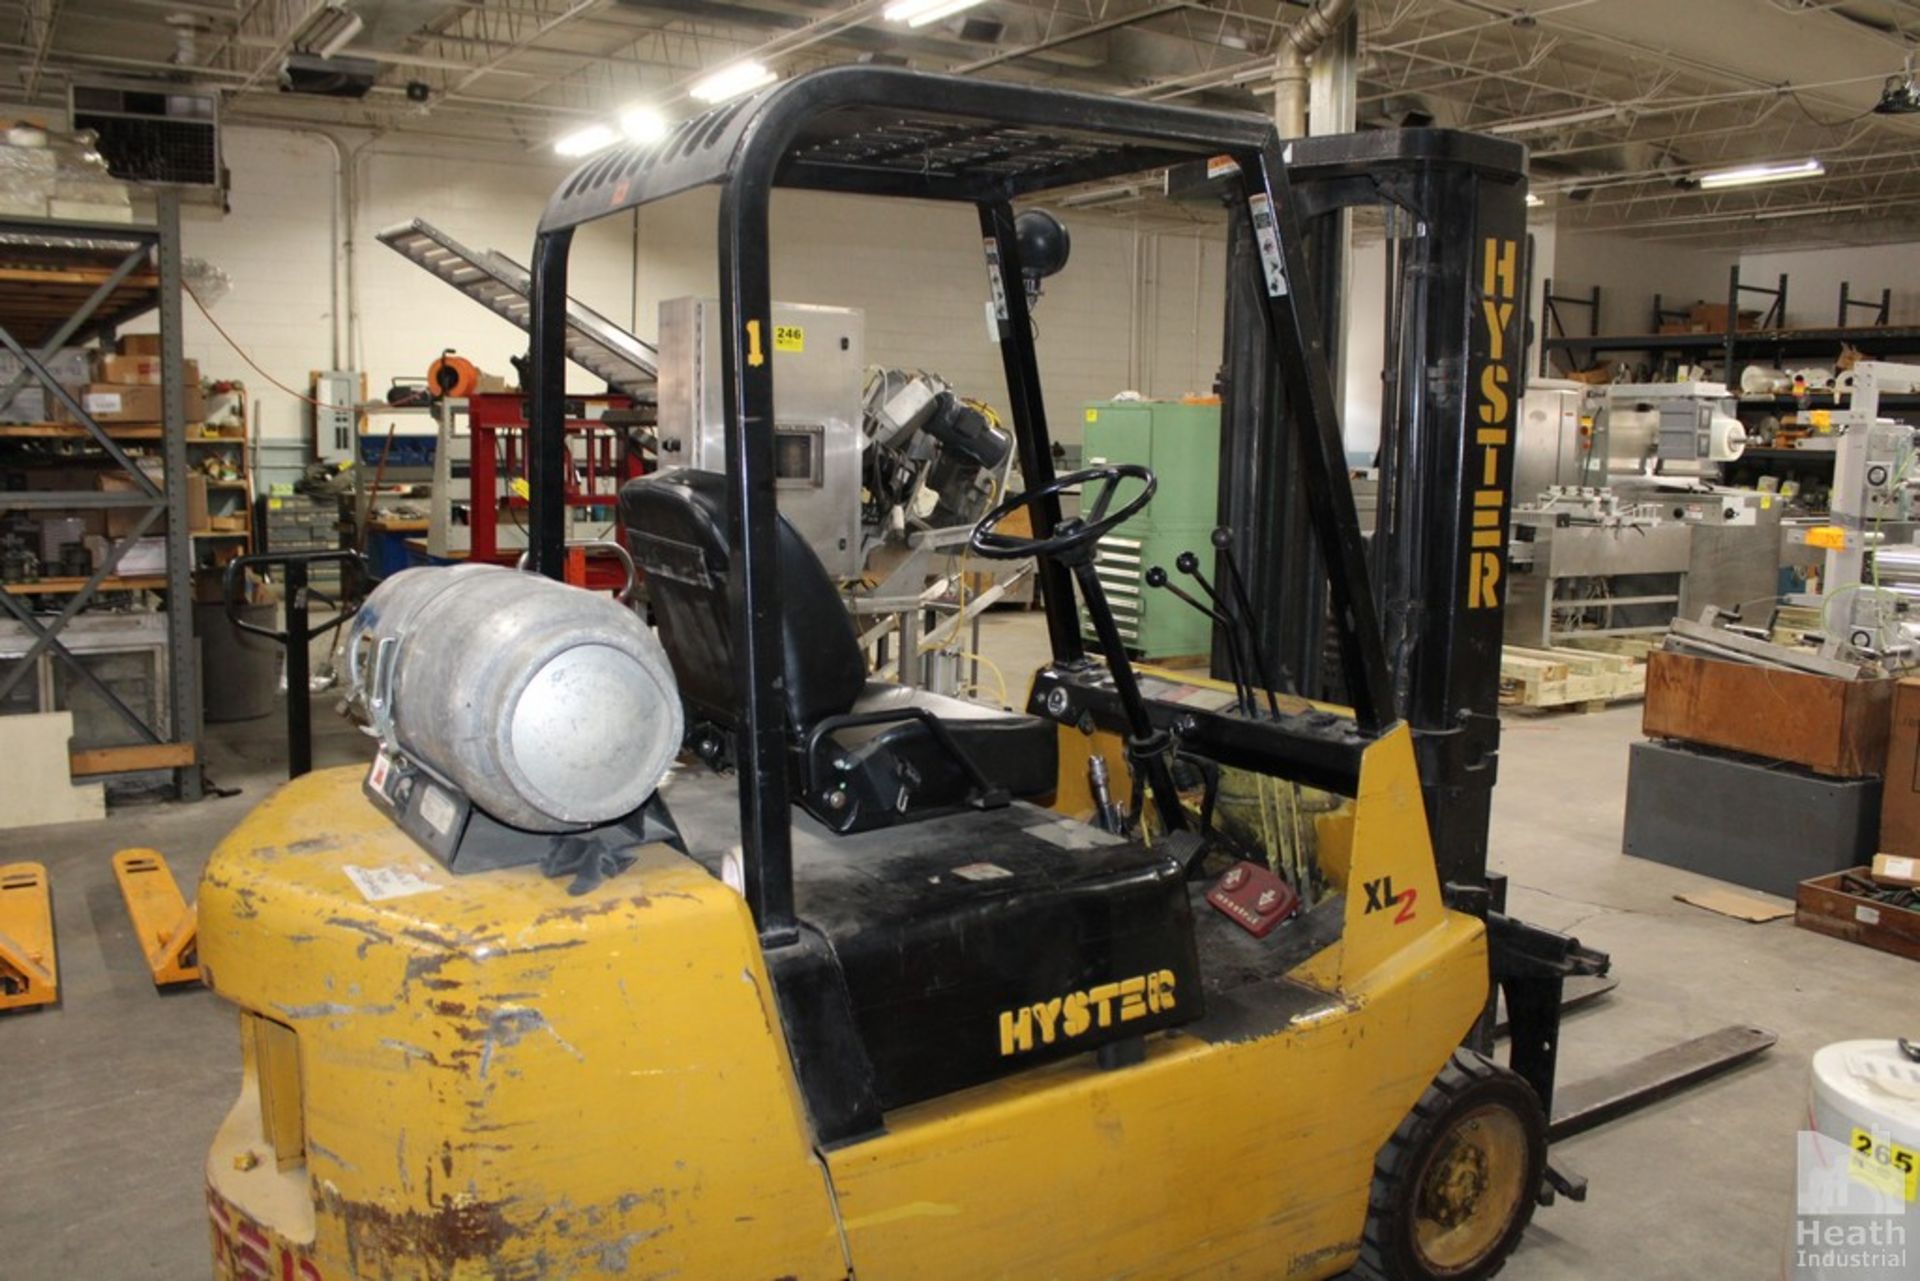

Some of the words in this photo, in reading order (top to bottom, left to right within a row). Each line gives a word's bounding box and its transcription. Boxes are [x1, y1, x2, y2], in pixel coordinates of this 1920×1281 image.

[746, 319, 764, 367] 1
[777, 327, 802, 340] 246
[1468, 238, 1516, 608] HYSTER
[999, 969, 1176, 1055] HYSTER
[1856, 1135, 1913, 1174] 265
